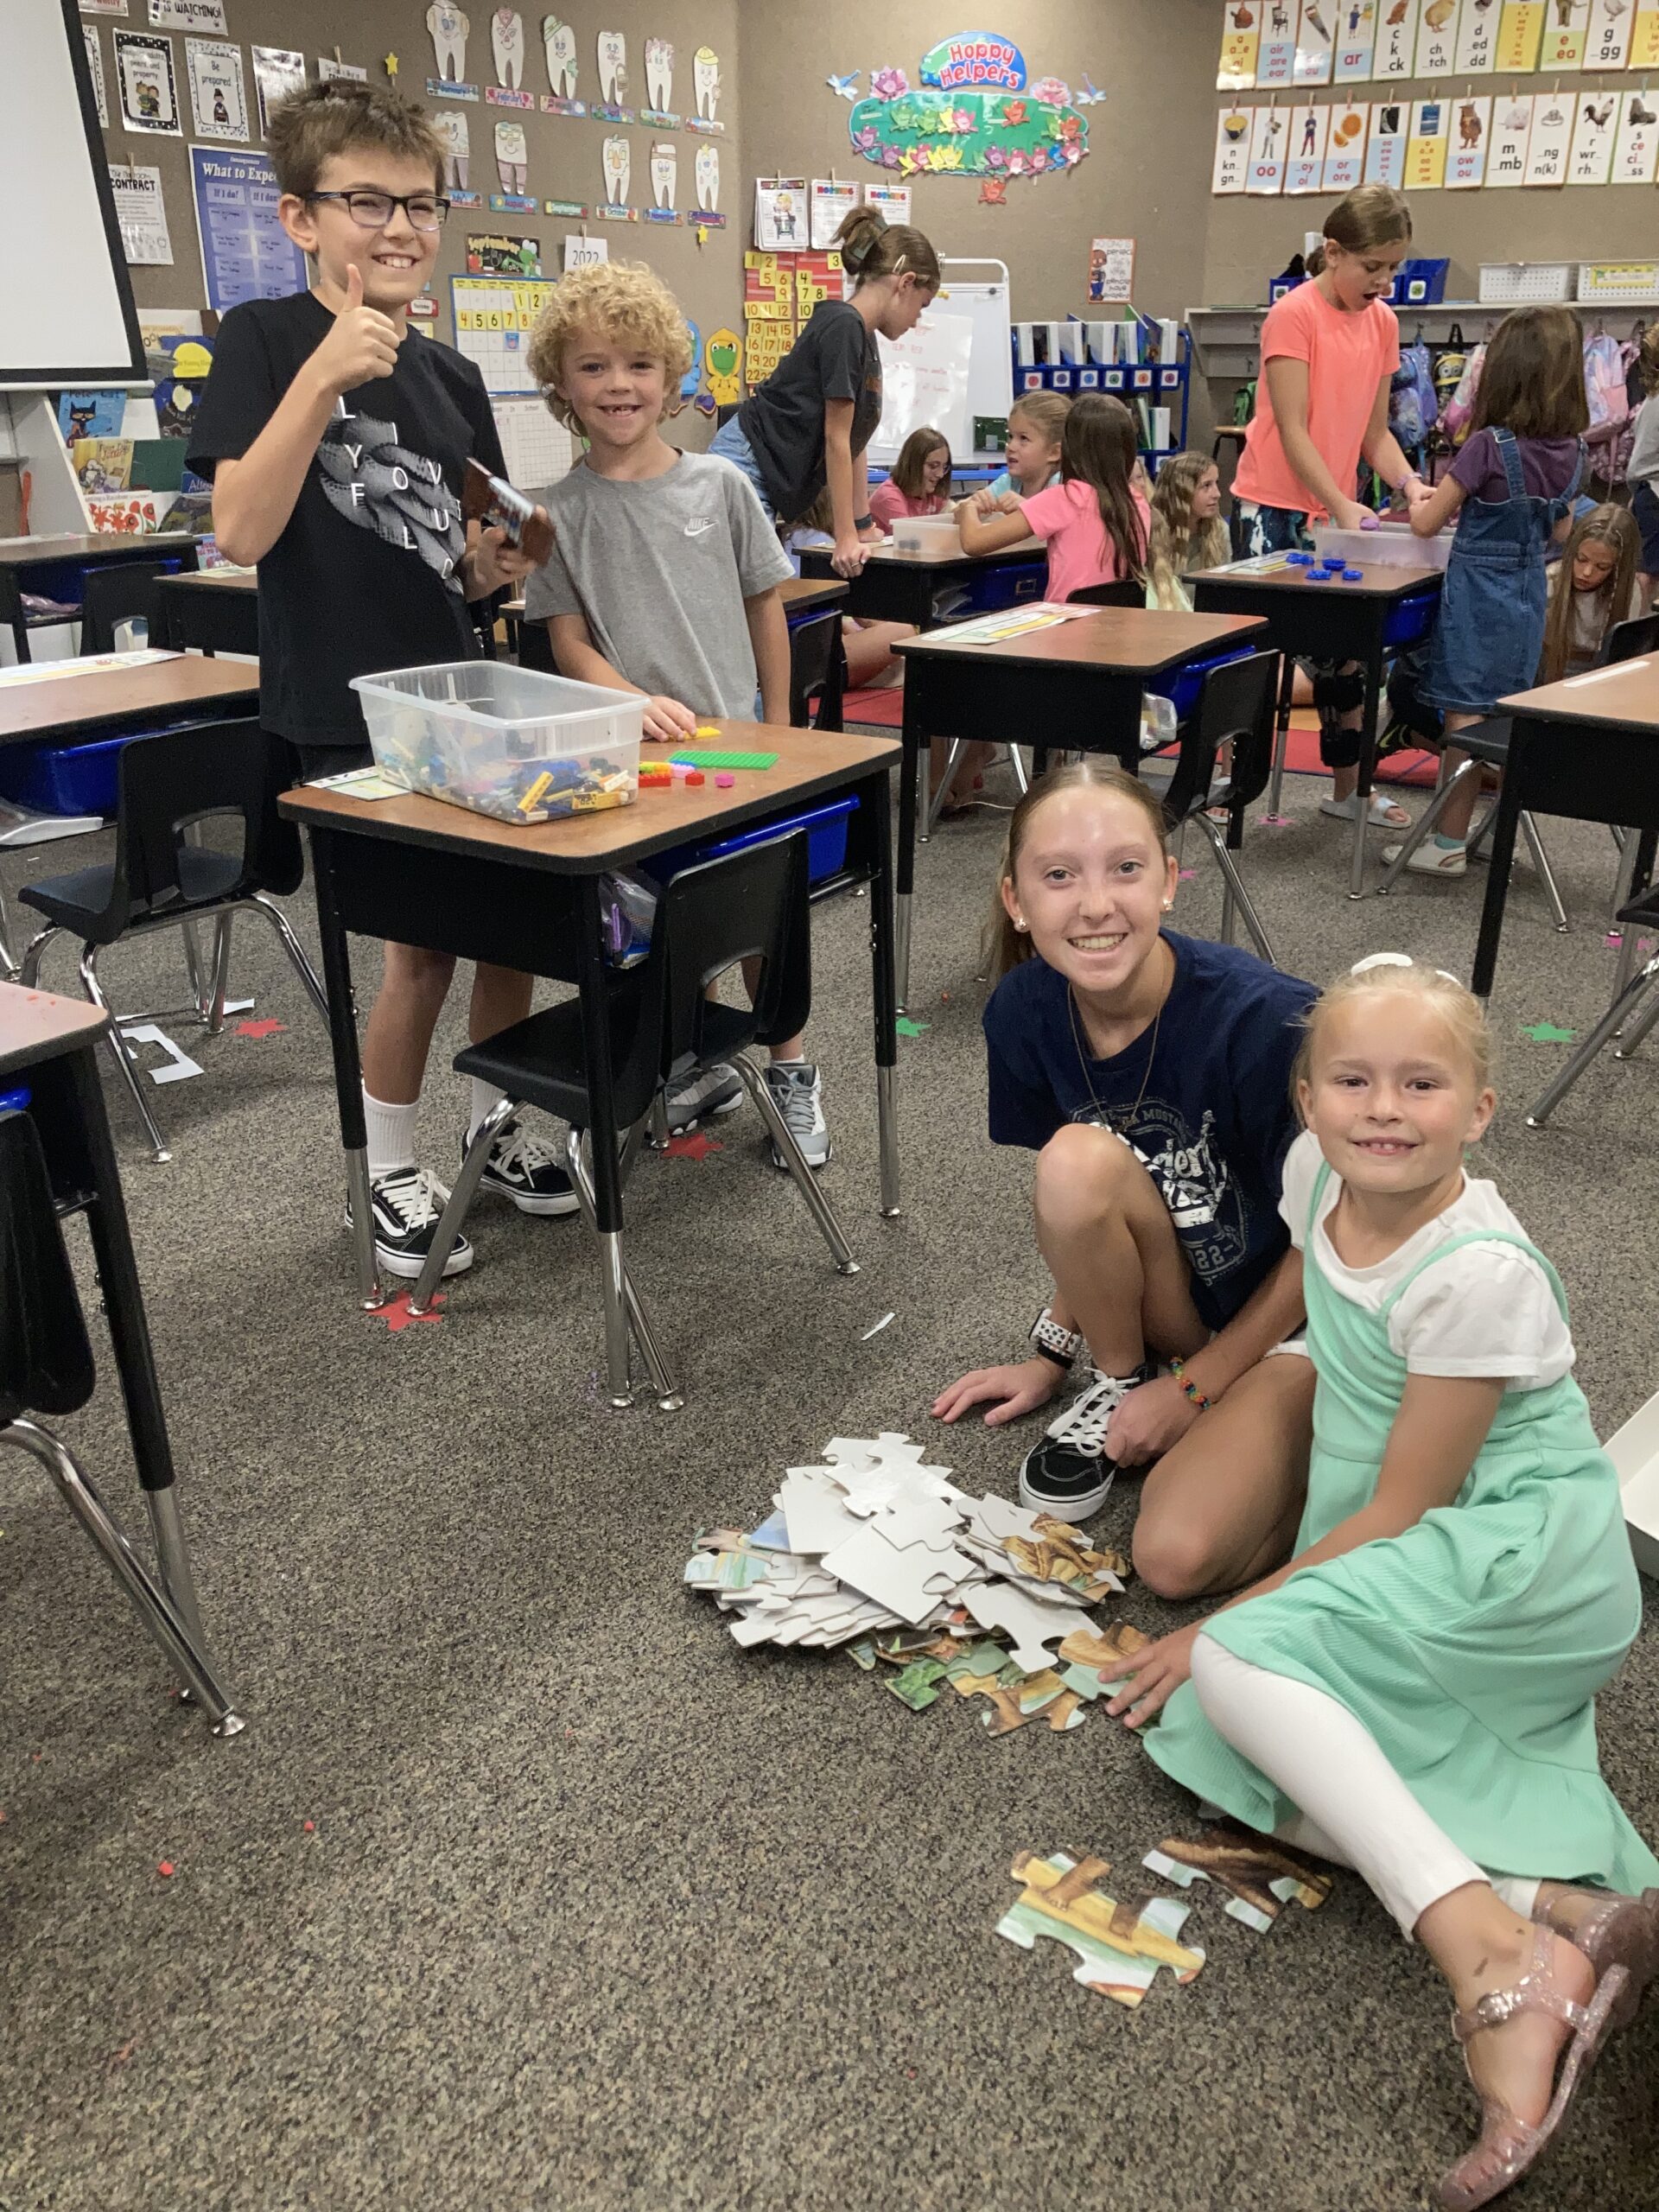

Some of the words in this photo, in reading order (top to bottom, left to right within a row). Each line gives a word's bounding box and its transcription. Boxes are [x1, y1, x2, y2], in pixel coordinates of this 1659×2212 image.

[175, 3, 221, 18] WATCHING!
[1394, 29, 1400, 39] c
[1475, 25, 1482, 35] d
[1605, 29, 1613, 42] g
[1560, 35, 1568, 45] e
[1270, 46, 1284, 54] air
[1390, 42, 1398, 54] k
[1430, 45, 1442, 54] ch
[950, 43, 1014, 65] Hoppy
[1344, 53, 1363, 66] ar
[211, 60, 220, 71] Be
[201, 76, 231, 86] prepared
[940, 63, 1020, 88] Helpers
[1637, 131, 1642, 140] s
[1503, 144, 1515, 153] m
[1338, 160, 1348, 169] or
[1458, 156, 1475, 166] ow
[202, 162, 232, 178] What
[235, 168, 245, 179] to
[1257, 166, 1276, 176] oo
[1333, 173, 1351, 181] ore
[111, 178, 156, 191] CONTRACT
[573, 251, 600, 265] 2022
[766, 256, 772, 268] 2
[833, 256, 839, 266] 3
[764, 273, 771, 283] 5
[780, 274, 787, 285] 6
[800, 272, 807, 283] 4
[779, 288, 787, 299] 9
[802, 288, 809, 299] 7
[816, 288, 823, 299] 8
[534, 294, 539, 308] 2
[747, 304, 758, 315] 10
[779, 305, 788, 316] 12
[800, 304, 810, 316] 10
[461, 315, 467, 327] 4
[476, 314, 483, 327] 5
[491, 314, 498, 327] 6
[506, 313, 512, 326] 7
[522, 315, 528, 327] 8
[751, 322, 761, 334] 13
[766, 325, 777, 336] 14
[780, 324, 791, 335] 15
[748, 339, 759, 350] 16
[765, 340, 774, 351] 17
[781, 340, 791, 352] 18
[750, 354, 760, 365] 19
[762, 356, 776, 367] 20
[747, 369, 760, 380] 22
